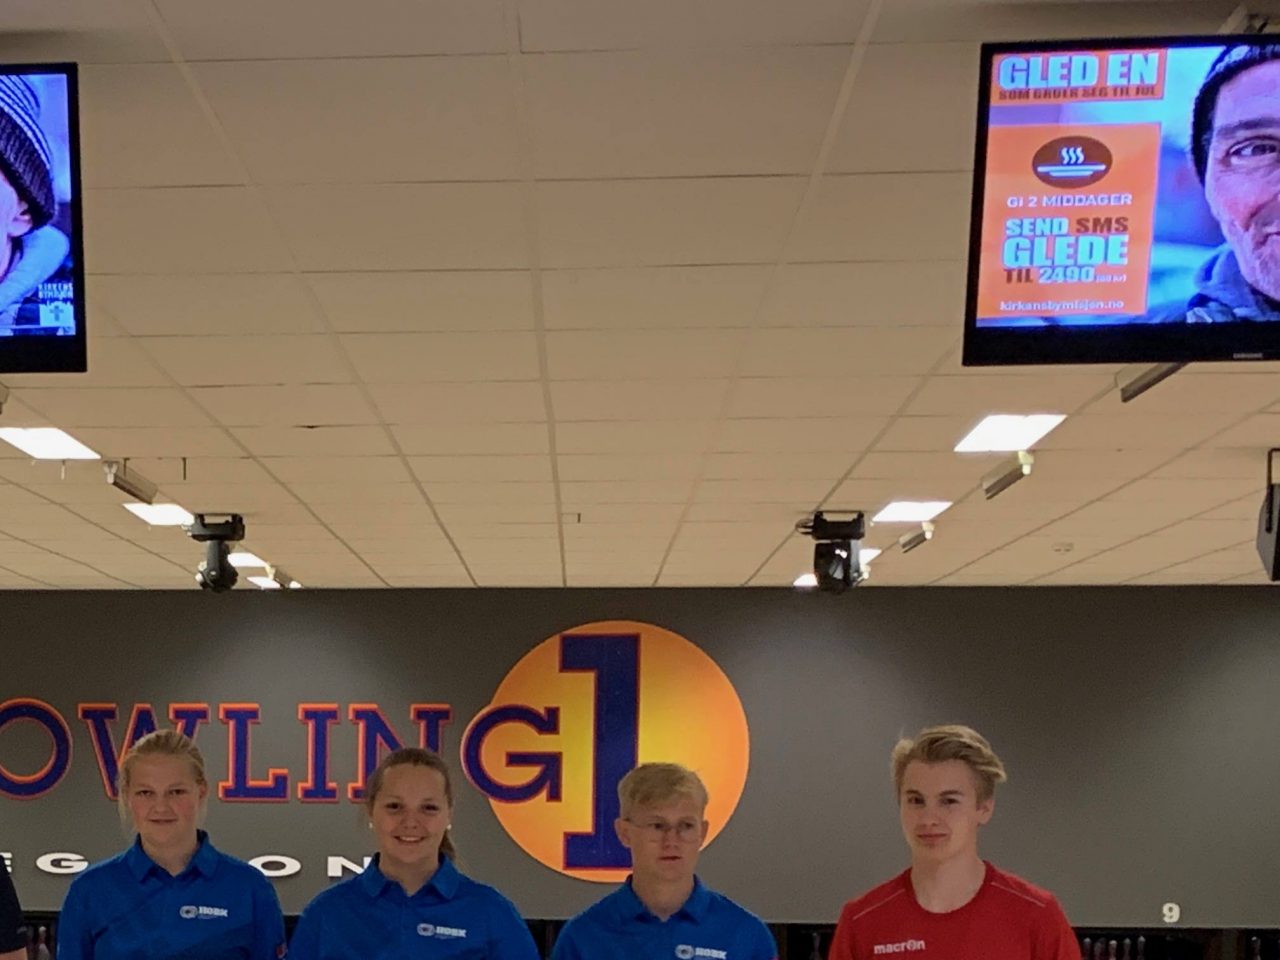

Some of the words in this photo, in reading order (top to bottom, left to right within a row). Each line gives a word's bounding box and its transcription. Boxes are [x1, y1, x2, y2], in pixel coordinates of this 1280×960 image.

[1000, 55, 1099, 90] GLED
[1107, 53, 1159, 86] EN
[1007, 196, 1024, 208] GI
[1028, 196, 1038, 208] 2
[1042, 193, 1133, 207] MIDDAGER
[1005, 217, 1069, 236] SEND
[1075, 216, 1129, 234] SMS
[1003, 234, 1129, 268] GLEDE
[1004, 268, 1033, 284] TIL
[1038, 266, 1095, 284] 2490
[1162, 902, 1181, 923] 9
